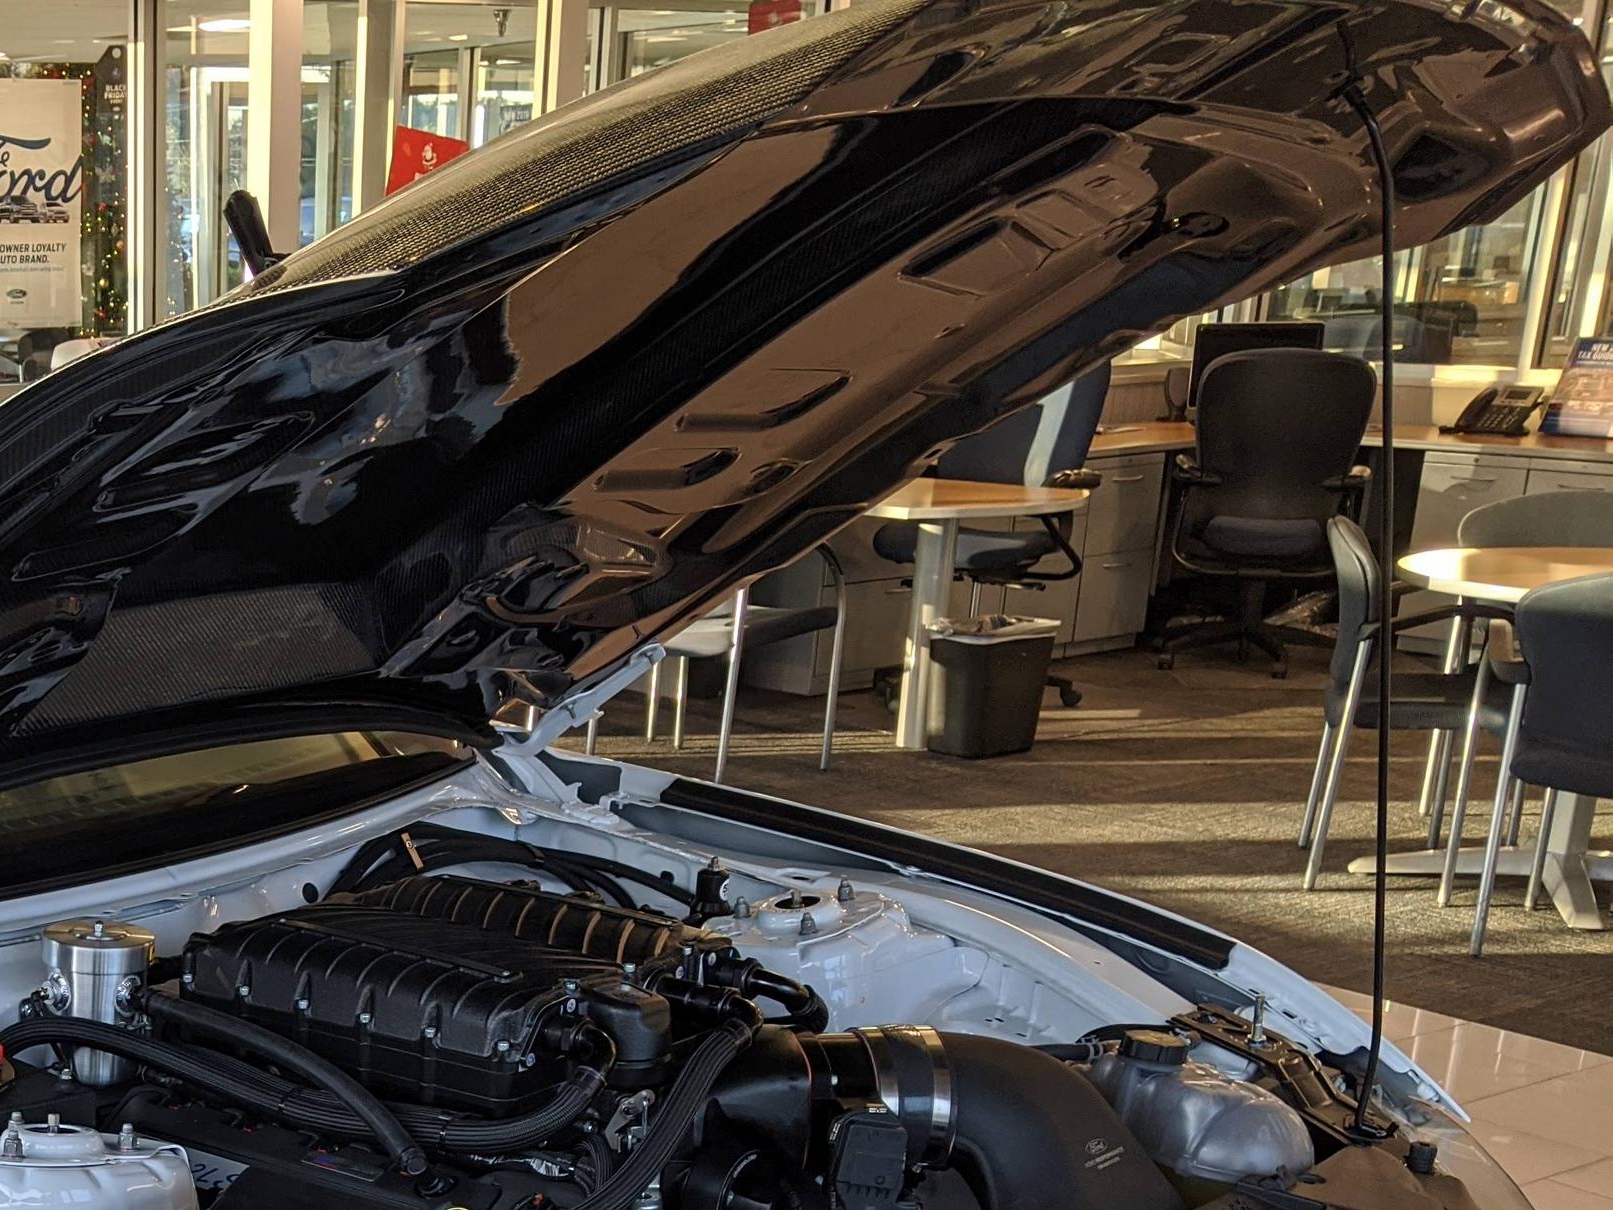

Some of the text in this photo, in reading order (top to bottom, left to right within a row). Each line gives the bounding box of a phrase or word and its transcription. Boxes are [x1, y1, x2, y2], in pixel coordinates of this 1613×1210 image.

[0, 244, 30, 253] OWNER
[31, 242, 67, 252] LOYALTY
[19, 254, 50, 264] BRAND.
